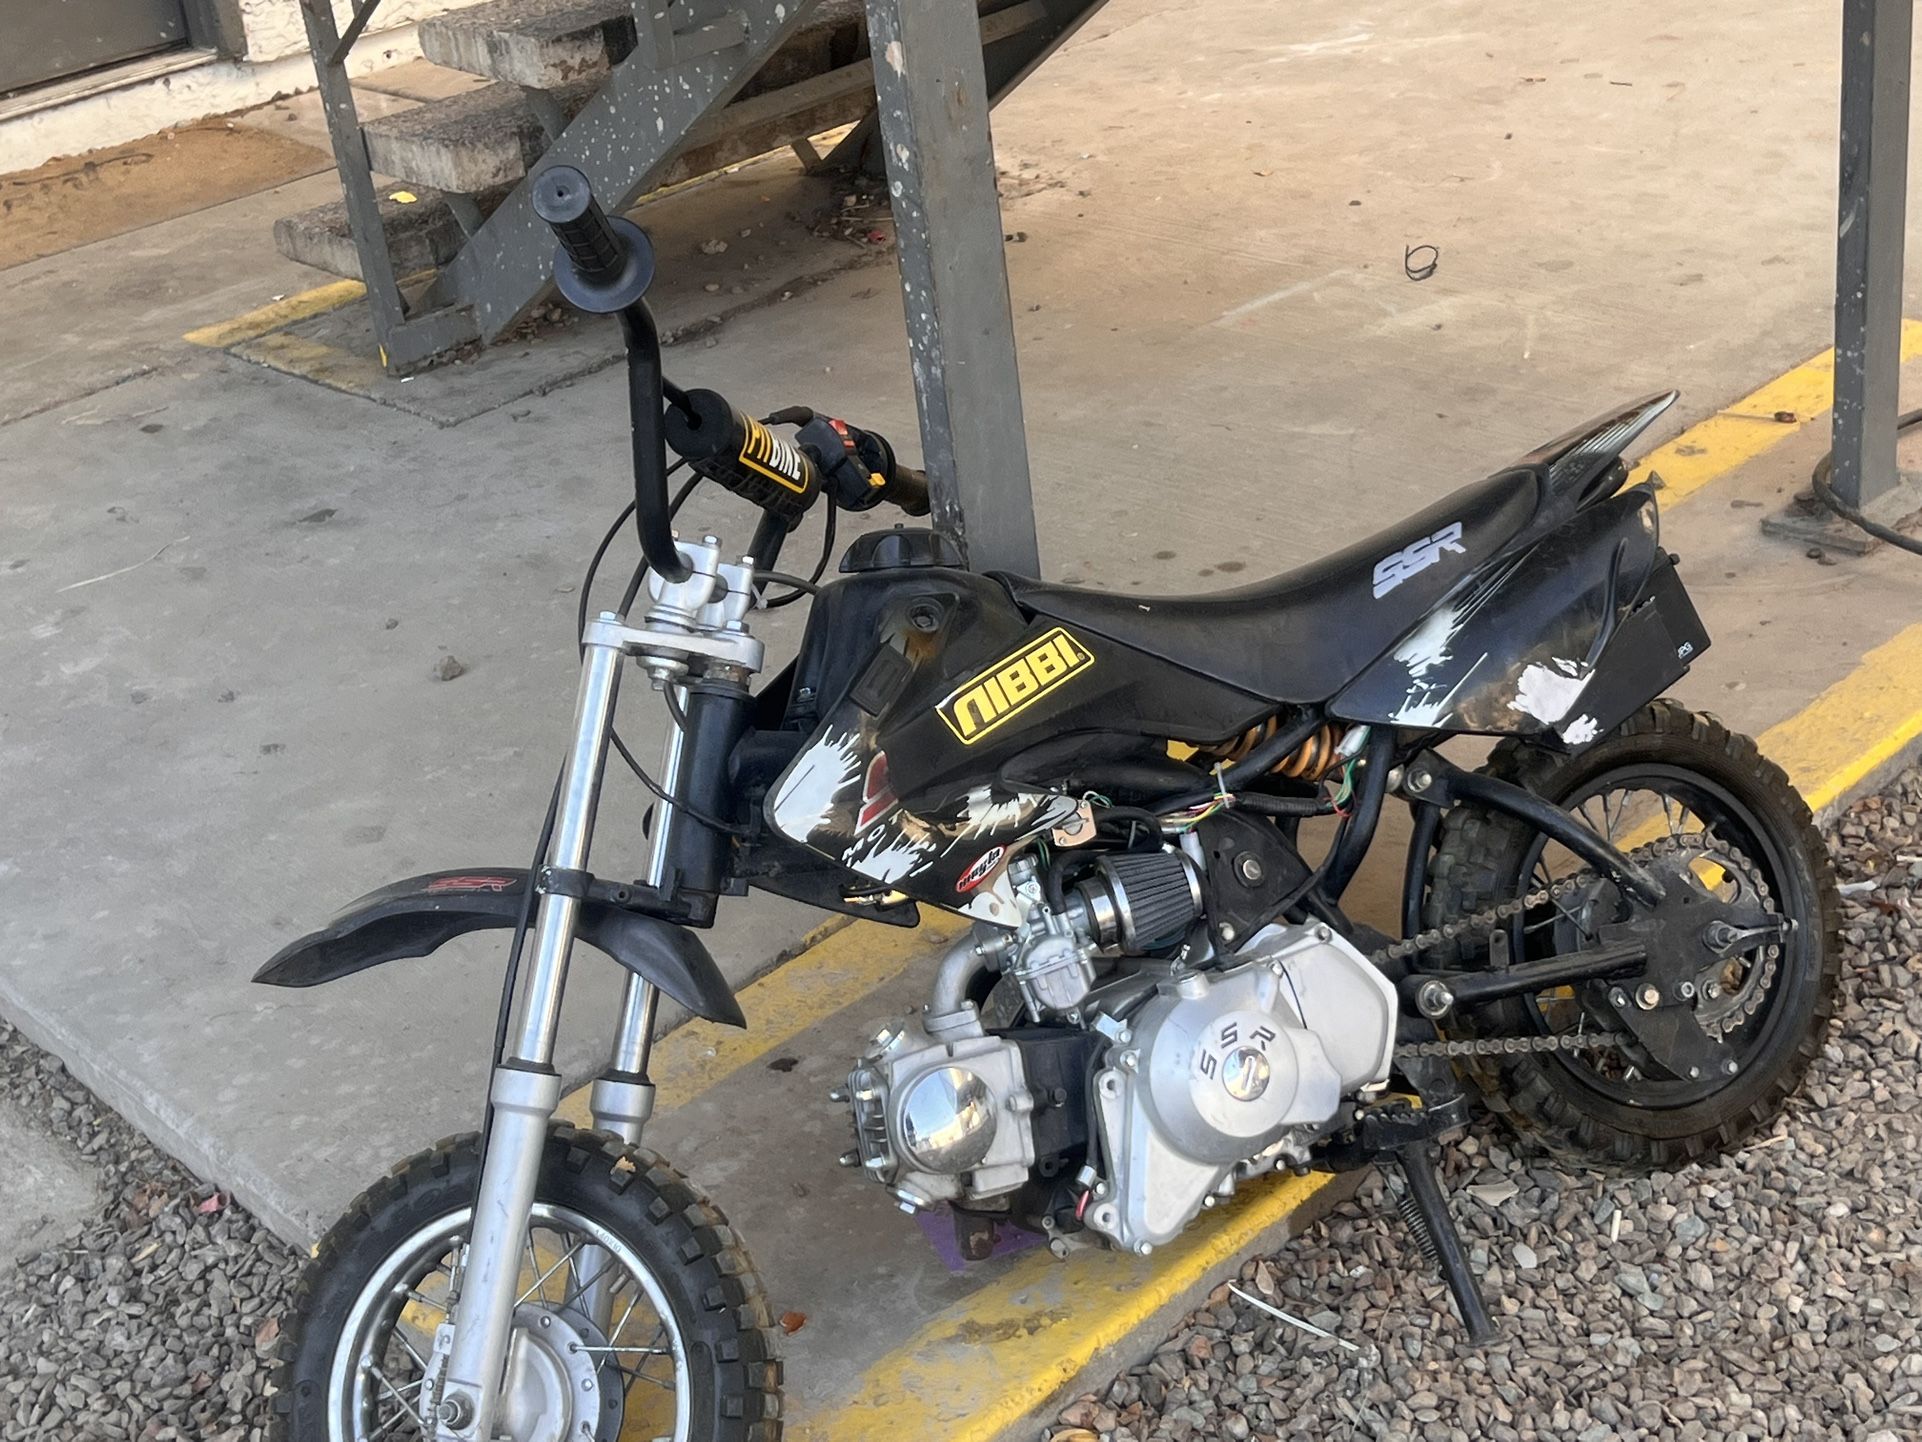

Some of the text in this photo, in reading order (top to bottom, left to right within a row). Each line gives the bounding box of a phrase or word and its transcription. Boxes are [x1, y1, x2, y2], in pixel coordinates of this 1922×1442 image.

[1373, 521, 1467, 600] SSR
[953, 634, 1081, 737] NIBBI
[1200, 1022, 1276, 1080] SSR
